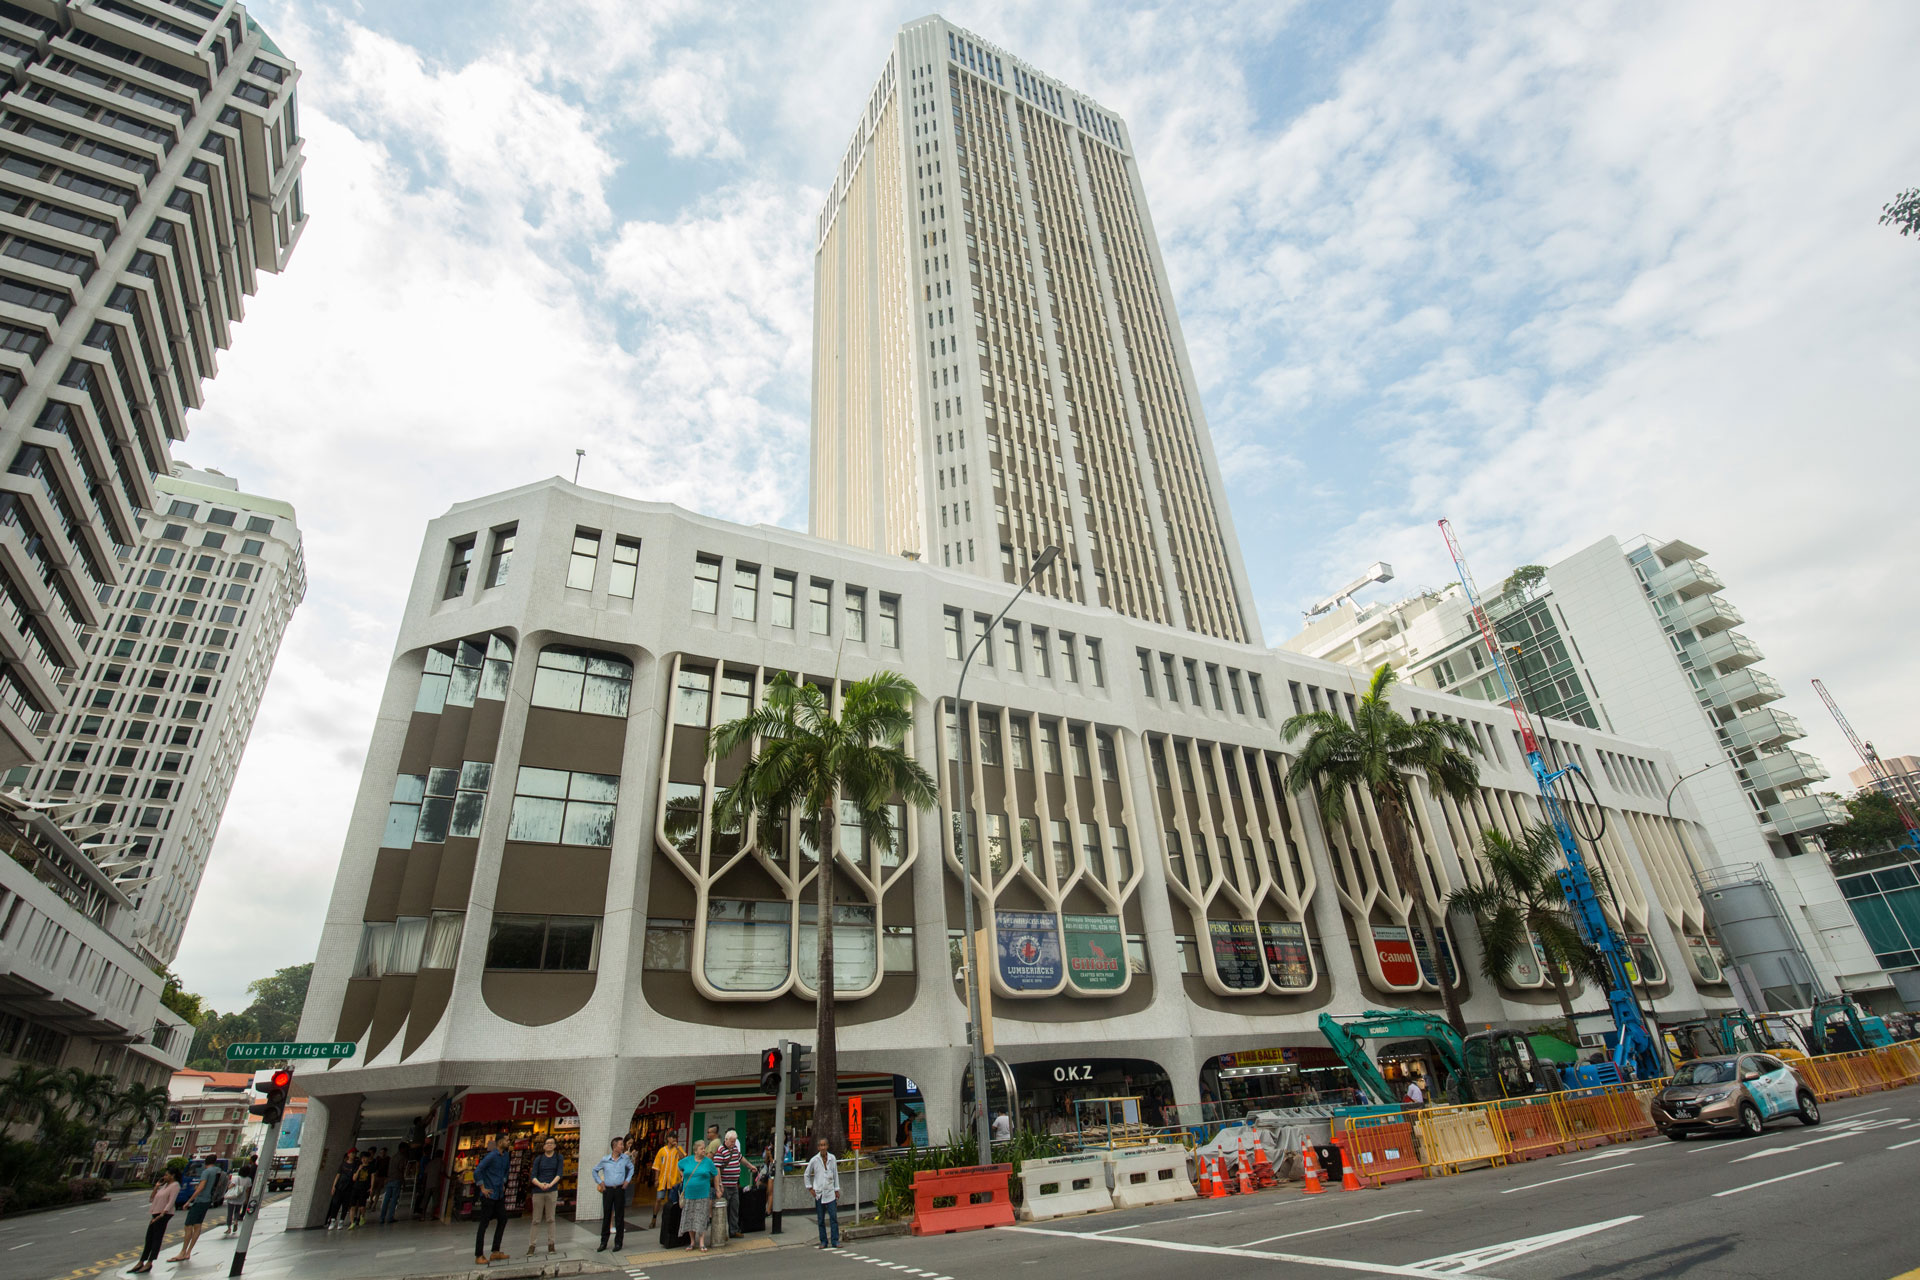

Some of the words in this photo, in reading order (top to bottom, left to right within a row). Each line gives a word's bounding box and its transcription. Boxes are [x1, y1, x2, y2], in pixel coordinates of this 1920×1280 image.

[1210, 923, 1230, 933] PENG
[1232, 924, 1254, 934] KWEE
[1379, 951, 1412, 963] Canon
[235, 1045, 277, 1056] North
[282, 1044, 327, 1057] Bridge
[333, 1044, 349, 1054] Rd
[1053, 1065, 1093, 1082] O.K.Z
[507, 1097, 549, 1116] THE
